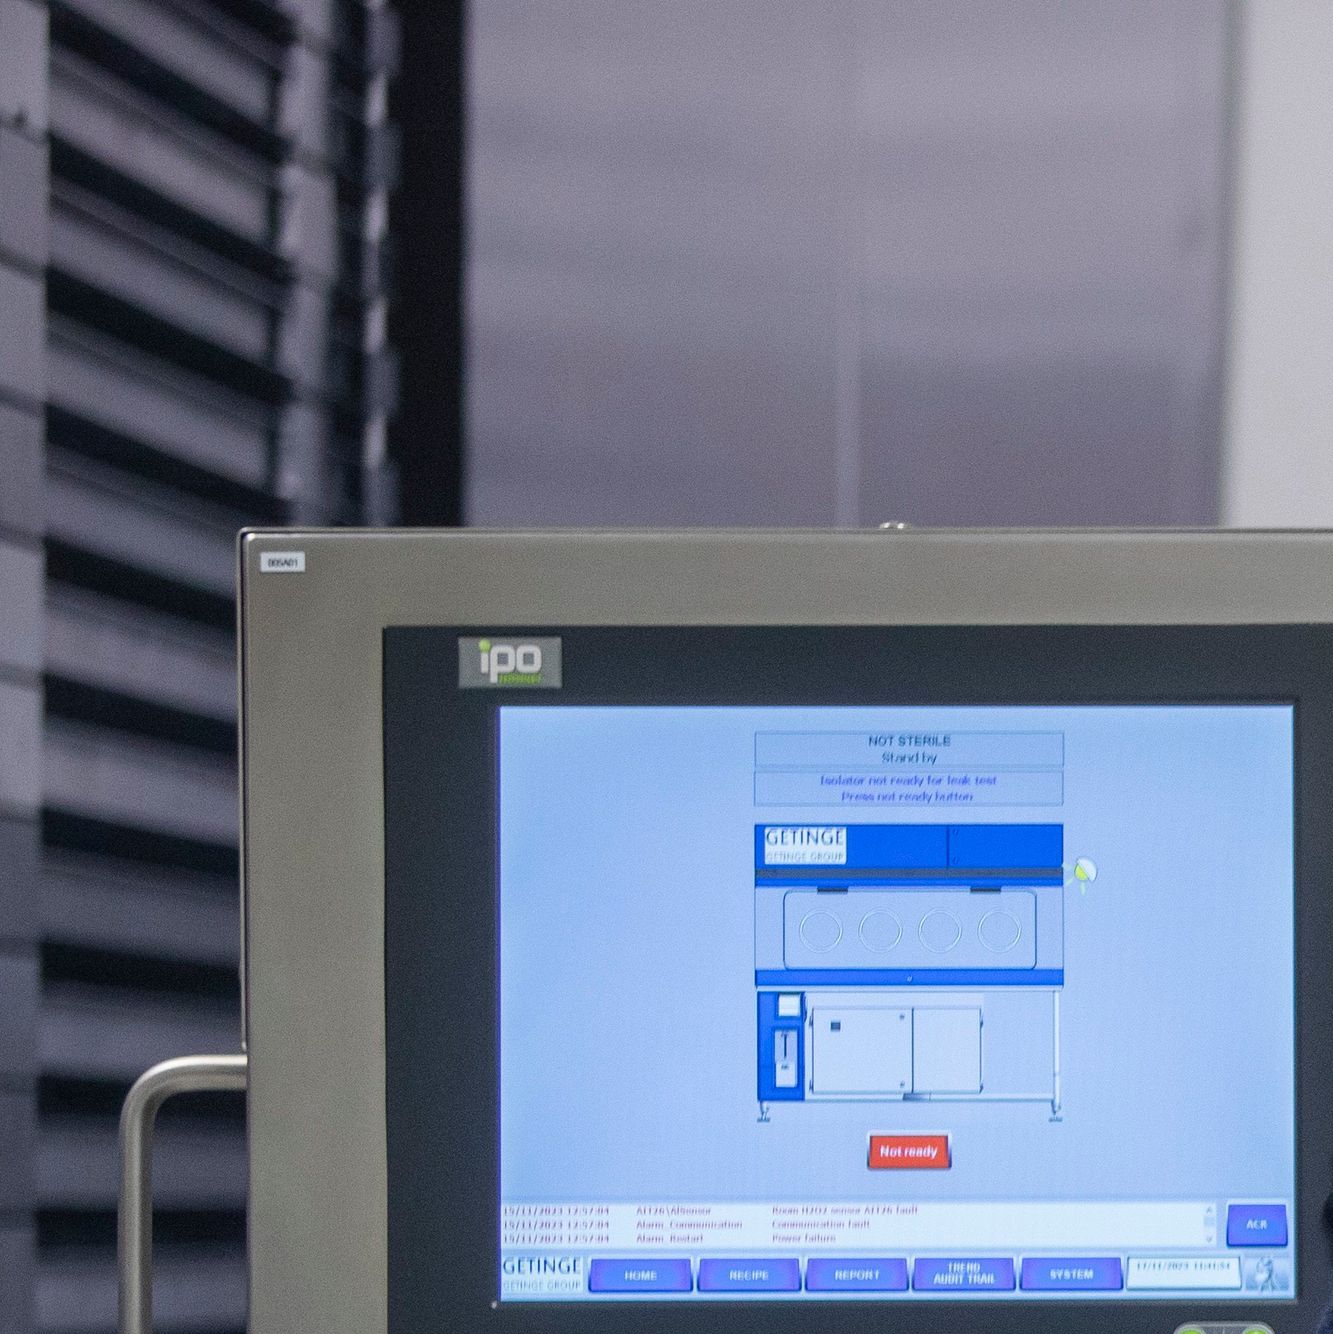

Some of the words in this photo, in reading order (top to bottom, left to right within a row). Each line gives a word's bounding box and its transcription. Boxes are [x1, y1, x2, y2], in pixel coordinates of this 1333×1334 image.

[478, 639, 543, 683] ipo
[868, 736, 894, 747] NOT
[898, 736, 951, 747] STERILE
[868, 776, 887, 786] not
[890, 775, 924, 788] ready
[841, 791, 874, 801] Press
[877, 792, 896, 801] not
[899, 791, 933, 804] ready
[935, 791, 974, 801] button
[766, 828, 844, 846] GETINGE
[880, 1145, 901, 1157] Not
[904, 1145, 938, 1159] ready
[503, 1256, 581, 1275] GETINGE
[624, 1270, 658, 1281] HOME
[729, 1269, 769, 1281] RECIPE
[834, 1269, 880, 1281] REPORT
[933, 1273, 964, 1285] AUDIT
[967, 1273, 995, 1285] TRAIL
[1050, 1268, 1094, 1280] SYSTEM
